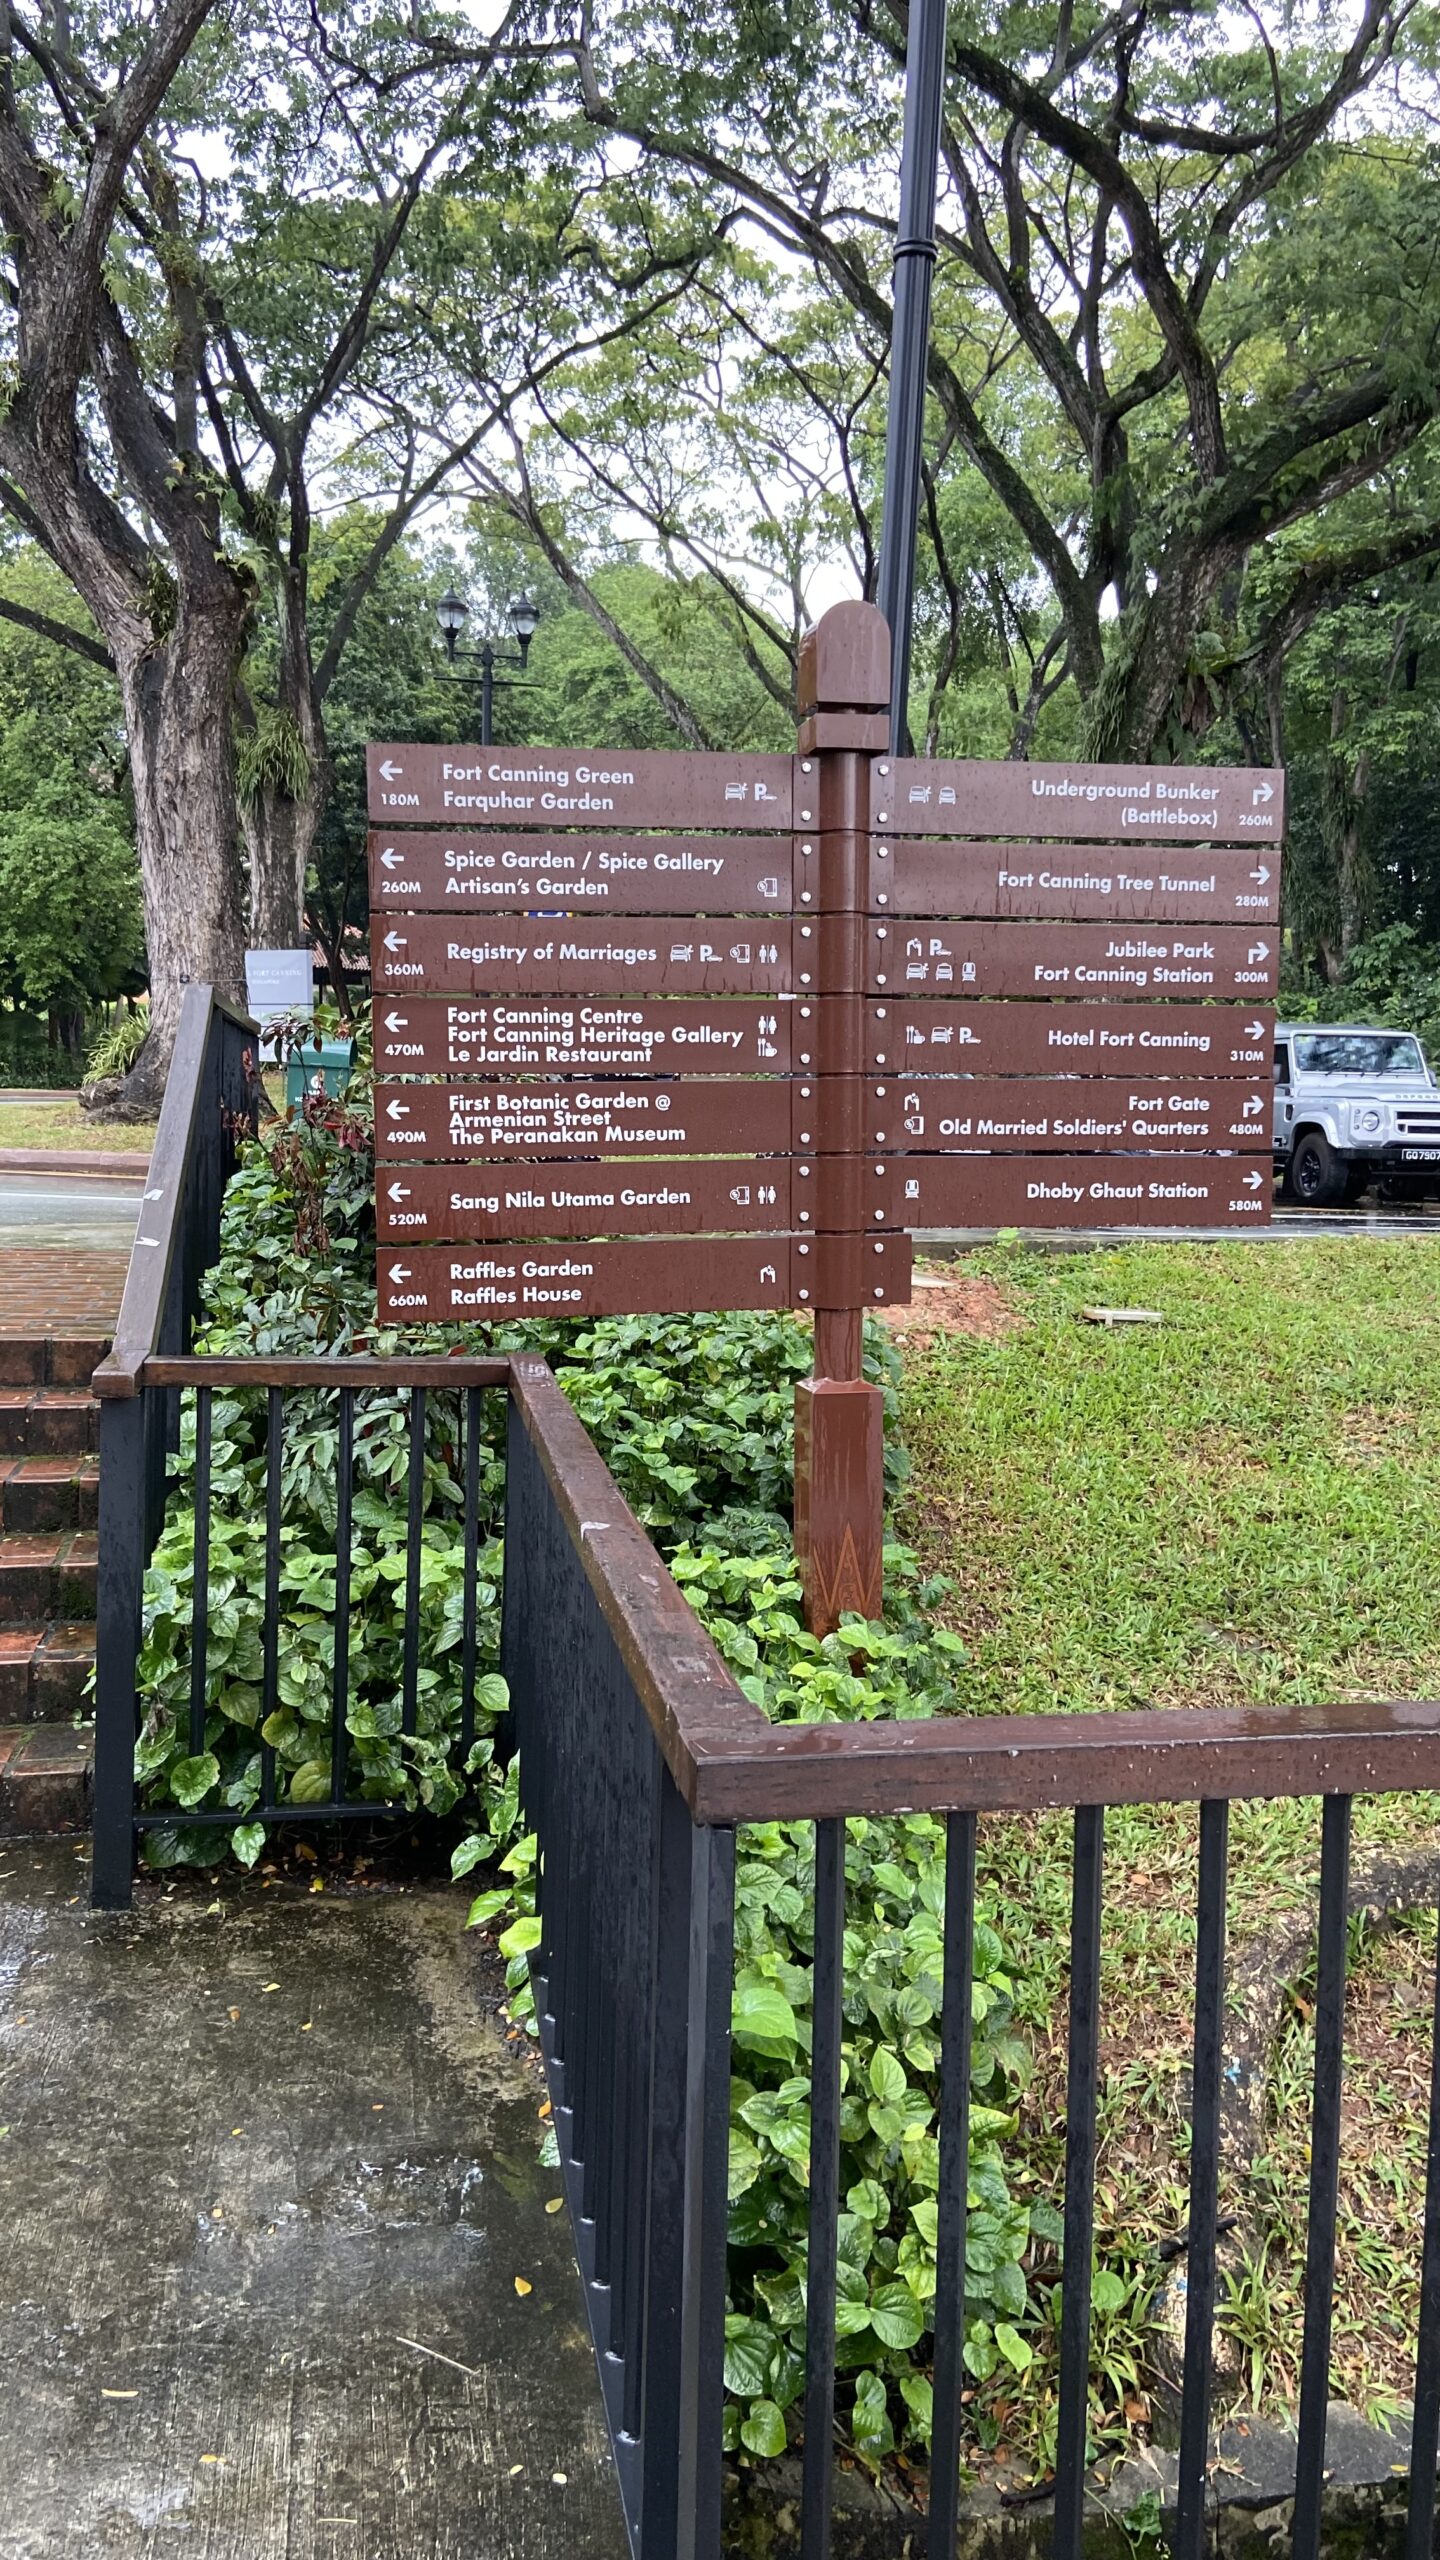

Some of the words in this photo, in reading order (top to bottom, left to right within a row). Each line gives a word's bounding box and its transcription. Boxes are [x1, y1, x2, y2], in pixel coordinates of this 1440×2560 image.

[442, 762, 483, 781] Fort
[487, 764, 570, 788] Canning
[575, 766, 635, 785] Green
[1031, 776, 1153, 802] Underground
[1155, 780, 1221, 801] Bunker
[381, 793, 420, 806] 180M
[443, 789, 536, 813] Farquhar
[540, 791, 614, 811] Garden
[1120, 805, 1219, 830] (Battlebox)
[1237, 812, 1274, 827] 260M
[444, 849, 496, 872] Spice
[501, 850, 576, 869] Garden
[598, 851, 648, 874] Spice
[653, 852, 725, 876] Gallery
[381, 880, 422, 894] 260M
[535, 877, 609, 896] Garden
[998, 870, 1035, 888] Fort
[1038, 871, 1113, 894] Canning
[1116, 874, 1155, 891] Tree
[1158, 874, 1216, 893] Tunnel
[1234, 894, 1270, 908] 280M
[447, 942, 528, 965] Registry
[533, 942, 554, 960] of
[559, 943, 657, 965] Marriages
[1105, 940, 1168, 958] Jubilee
[1172, 941, 1216, 959] Park
[384, 963, 424, 976] 360M
[1034, 965, 1070, 981] Fort
[1074, 965, 1148, 987] Canning
[1152, 966, 1214, 983] Station
[1234, 971, 1269, 983] 300M
[447, 1006, 488, 1024] Fort
[492, 1006, 574, 1028] Canning
[579, 1007, 644, 1025] Centre
[448, 1026, 488, 1043] Fort
[493, 1025, 574, 1046] Canning
[580, 1025, 666, 1048] Heritage
[671, 1025, 744, 1048] Gallery
[1048, 1029, 1095, 1046] Hotel
[1099, 1030, 1135, 1047] Fort
[1138, 1031, 1211, 1052] Canning
[384, 1043, 425, 1056] 470M
[448, 1045, 471, 1063] Le
[476, 1044, 539, 1063] Jardin
[545, 1045, 653, 1063] Restaurant
[1230, 1050, 1264, 1062] 310M
[449, 1094, 491, 1112] First
[496, 1094, 570, 1111] Botanic
[575, 1091, 649, 1110] Garden
[654, 1094, 671, 1111] @
[1128, 1095, 1164, 1111] Fort
[1167, 1095, 1210, 1111] Gate
[449, 1111, 547, 1128] Armenian
[553, 1109, 612, 1127] Street
[939, 1118, 972, 1135] Old
[976, 1118, 1048, 1135] Married
[1052, 1118, 1127, 1135] Soldiers'
[1131, 1119, 1209, 1136] Quarters
[386, 1131, 427, 1143] 490M
[448, 1127, 485, 1145] The
[490, 1125, 599, 1144] Peranakan
[604, 1125, 686, 1142] Museum
[1228, 1123, 1264, 1135] 480M
[450, 1193, 499, 1214] Sang
[505, 1190, 545, 1209] Nila
[551, 1191, 615, 1207] Utama
[620, 1187, 691, 1206] Garden
[1027, 1181, 1085, 1203] Dhoby
[1089, 1181, 1144, 1199] Ghaut
[1148, 1182, 1209, 1198] Station
[1228, 1200, 1263, 1211] 580M
[388, 1213, 428, 1226] 520M
[450, 1261, 516, 1280] Raffles
[521, 1259, 593, 1278] Garden
[388, 1294, 428, 1307] 660M
[451, 1286, 517, 1305] Raffles
[523, 1286, 582, 1303] House
